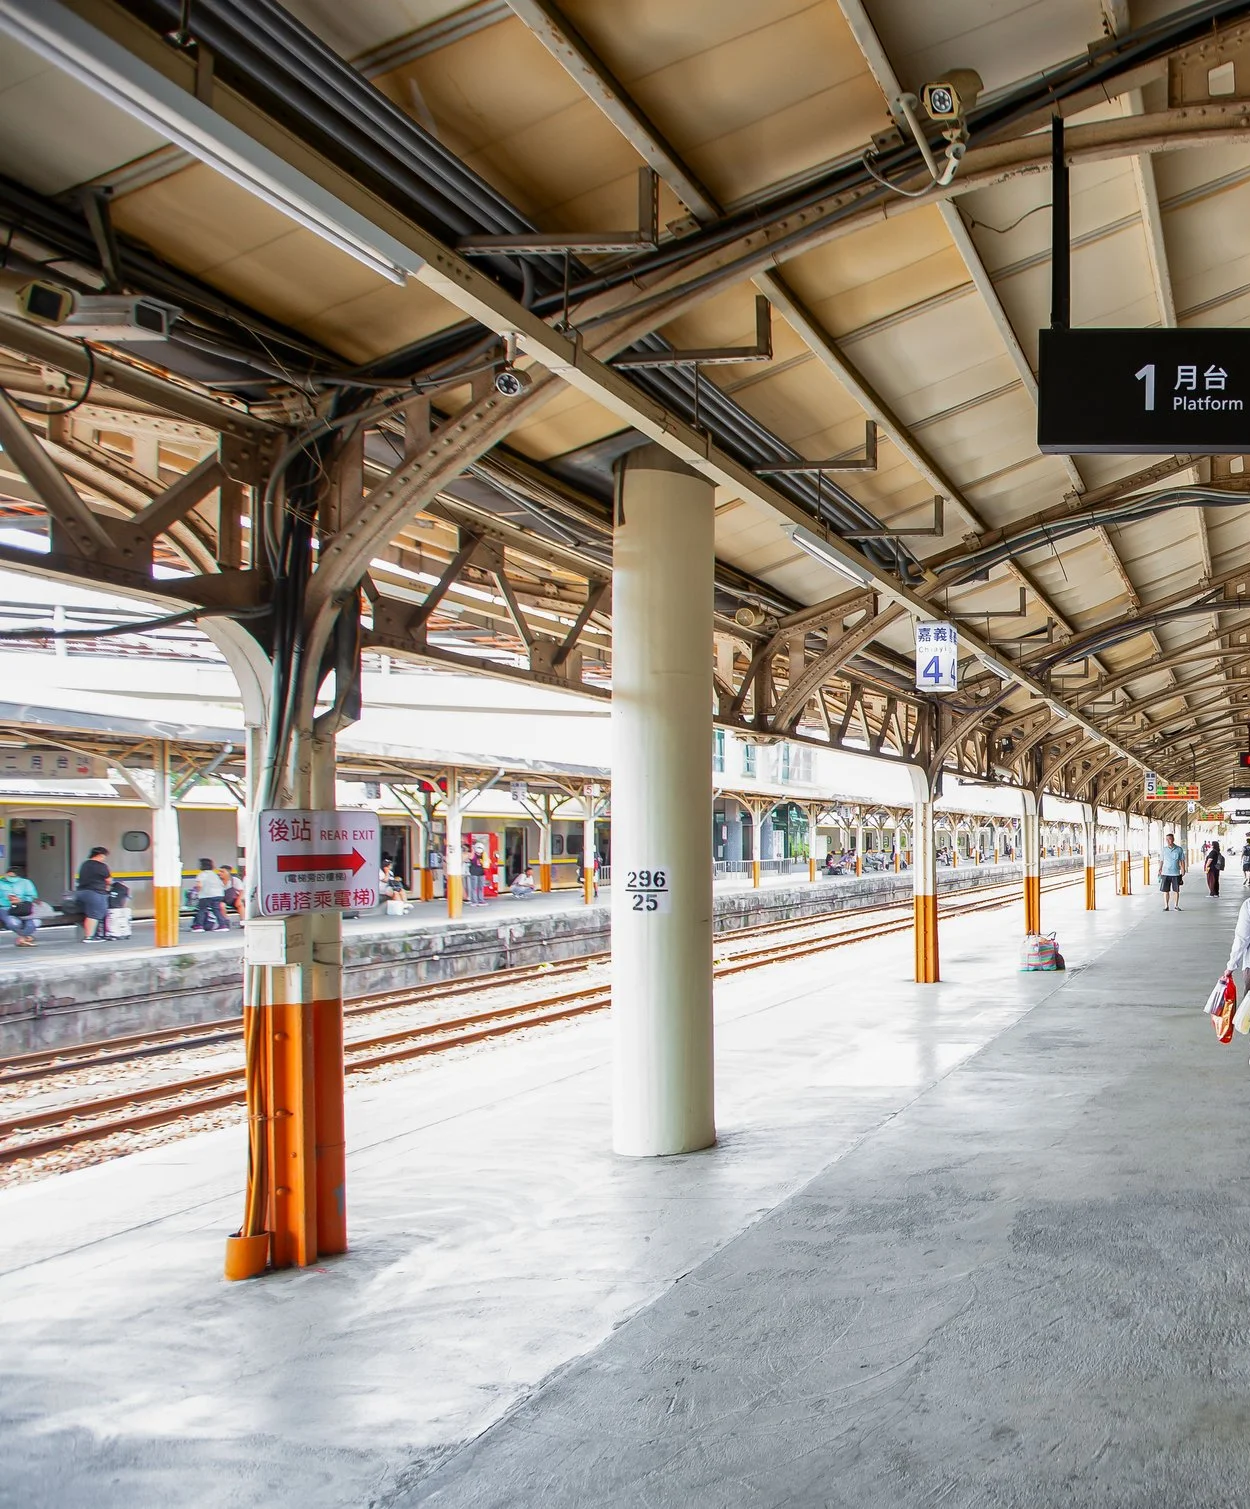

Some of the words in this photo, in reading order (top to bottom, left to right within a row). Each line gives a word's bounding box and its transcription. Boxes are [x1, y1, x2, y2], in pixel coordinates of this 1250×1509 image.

[1134, 364, 1155, 411] 1
[1174, 364, 1228, 390] 月台
[1173, 396, 1244, 411] Platform
[918, 627, 948, 642] 嘉義
[922, 655, 943, 684] 4
[1147, 781, 1155, 792] 5
[268, 818, 311, 842] 後站
[320, 830, 348, 841] REAR
[353, 829, 375, 840] EXIT
[627, 870, 666, 888] 296
[265, 888, 375, 914] (請搭乘電梯)
[632, 893, 658, 911] 25
